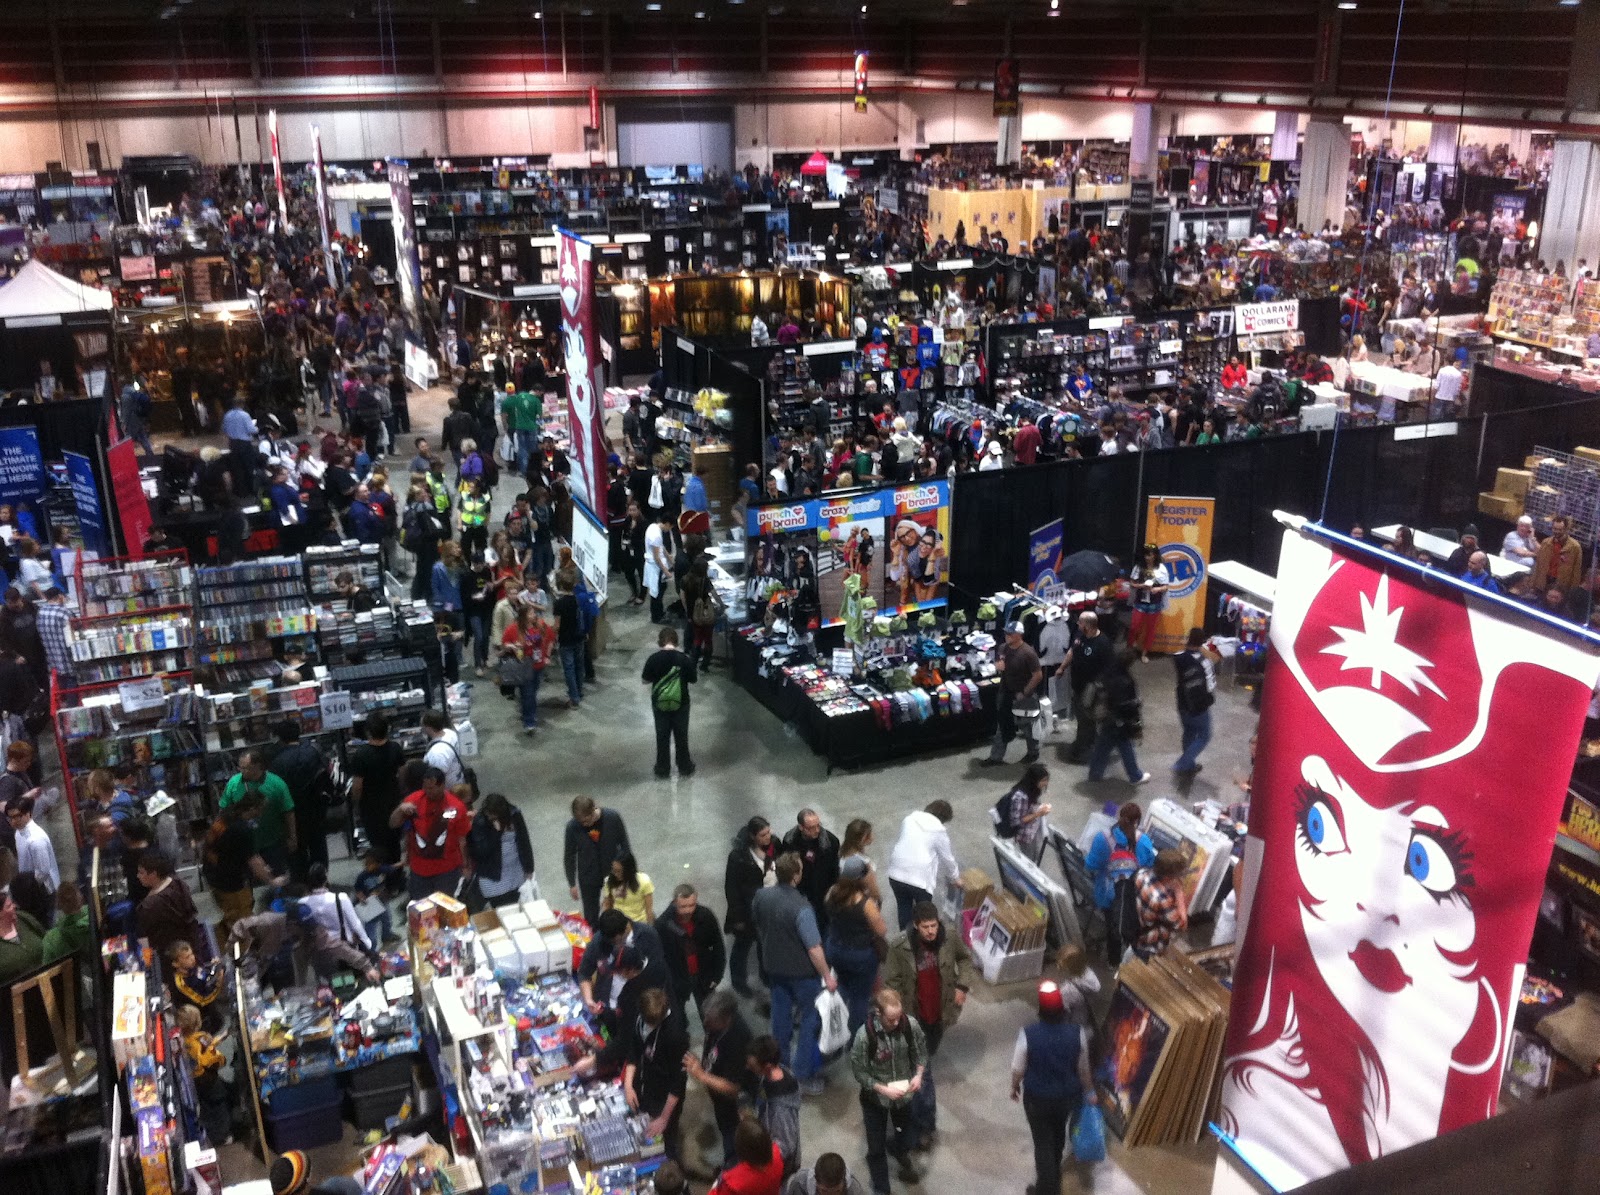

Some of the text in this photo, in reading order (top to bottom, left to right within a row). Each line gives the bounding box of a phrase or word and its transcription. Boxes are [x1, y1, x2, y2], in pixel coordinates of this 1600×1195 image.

[1242, 304, 1296, 317] DOLLARAMA
[1257, 317, 1286, 326] COMICS
[3, 446, 22, 456] THE
[0, 455, 37, 466] LTIMATE
[0, 464, 40, 475] ETWORK
[895, 489, 927, 504] punch
[908, 496, 938, 508] brand
[759, 508, 793, 523] punch
[821, 505, 850, 517] crazy
[773, 517, 806, 529] brand
[1163, 516, 1198, 526] TODAY
